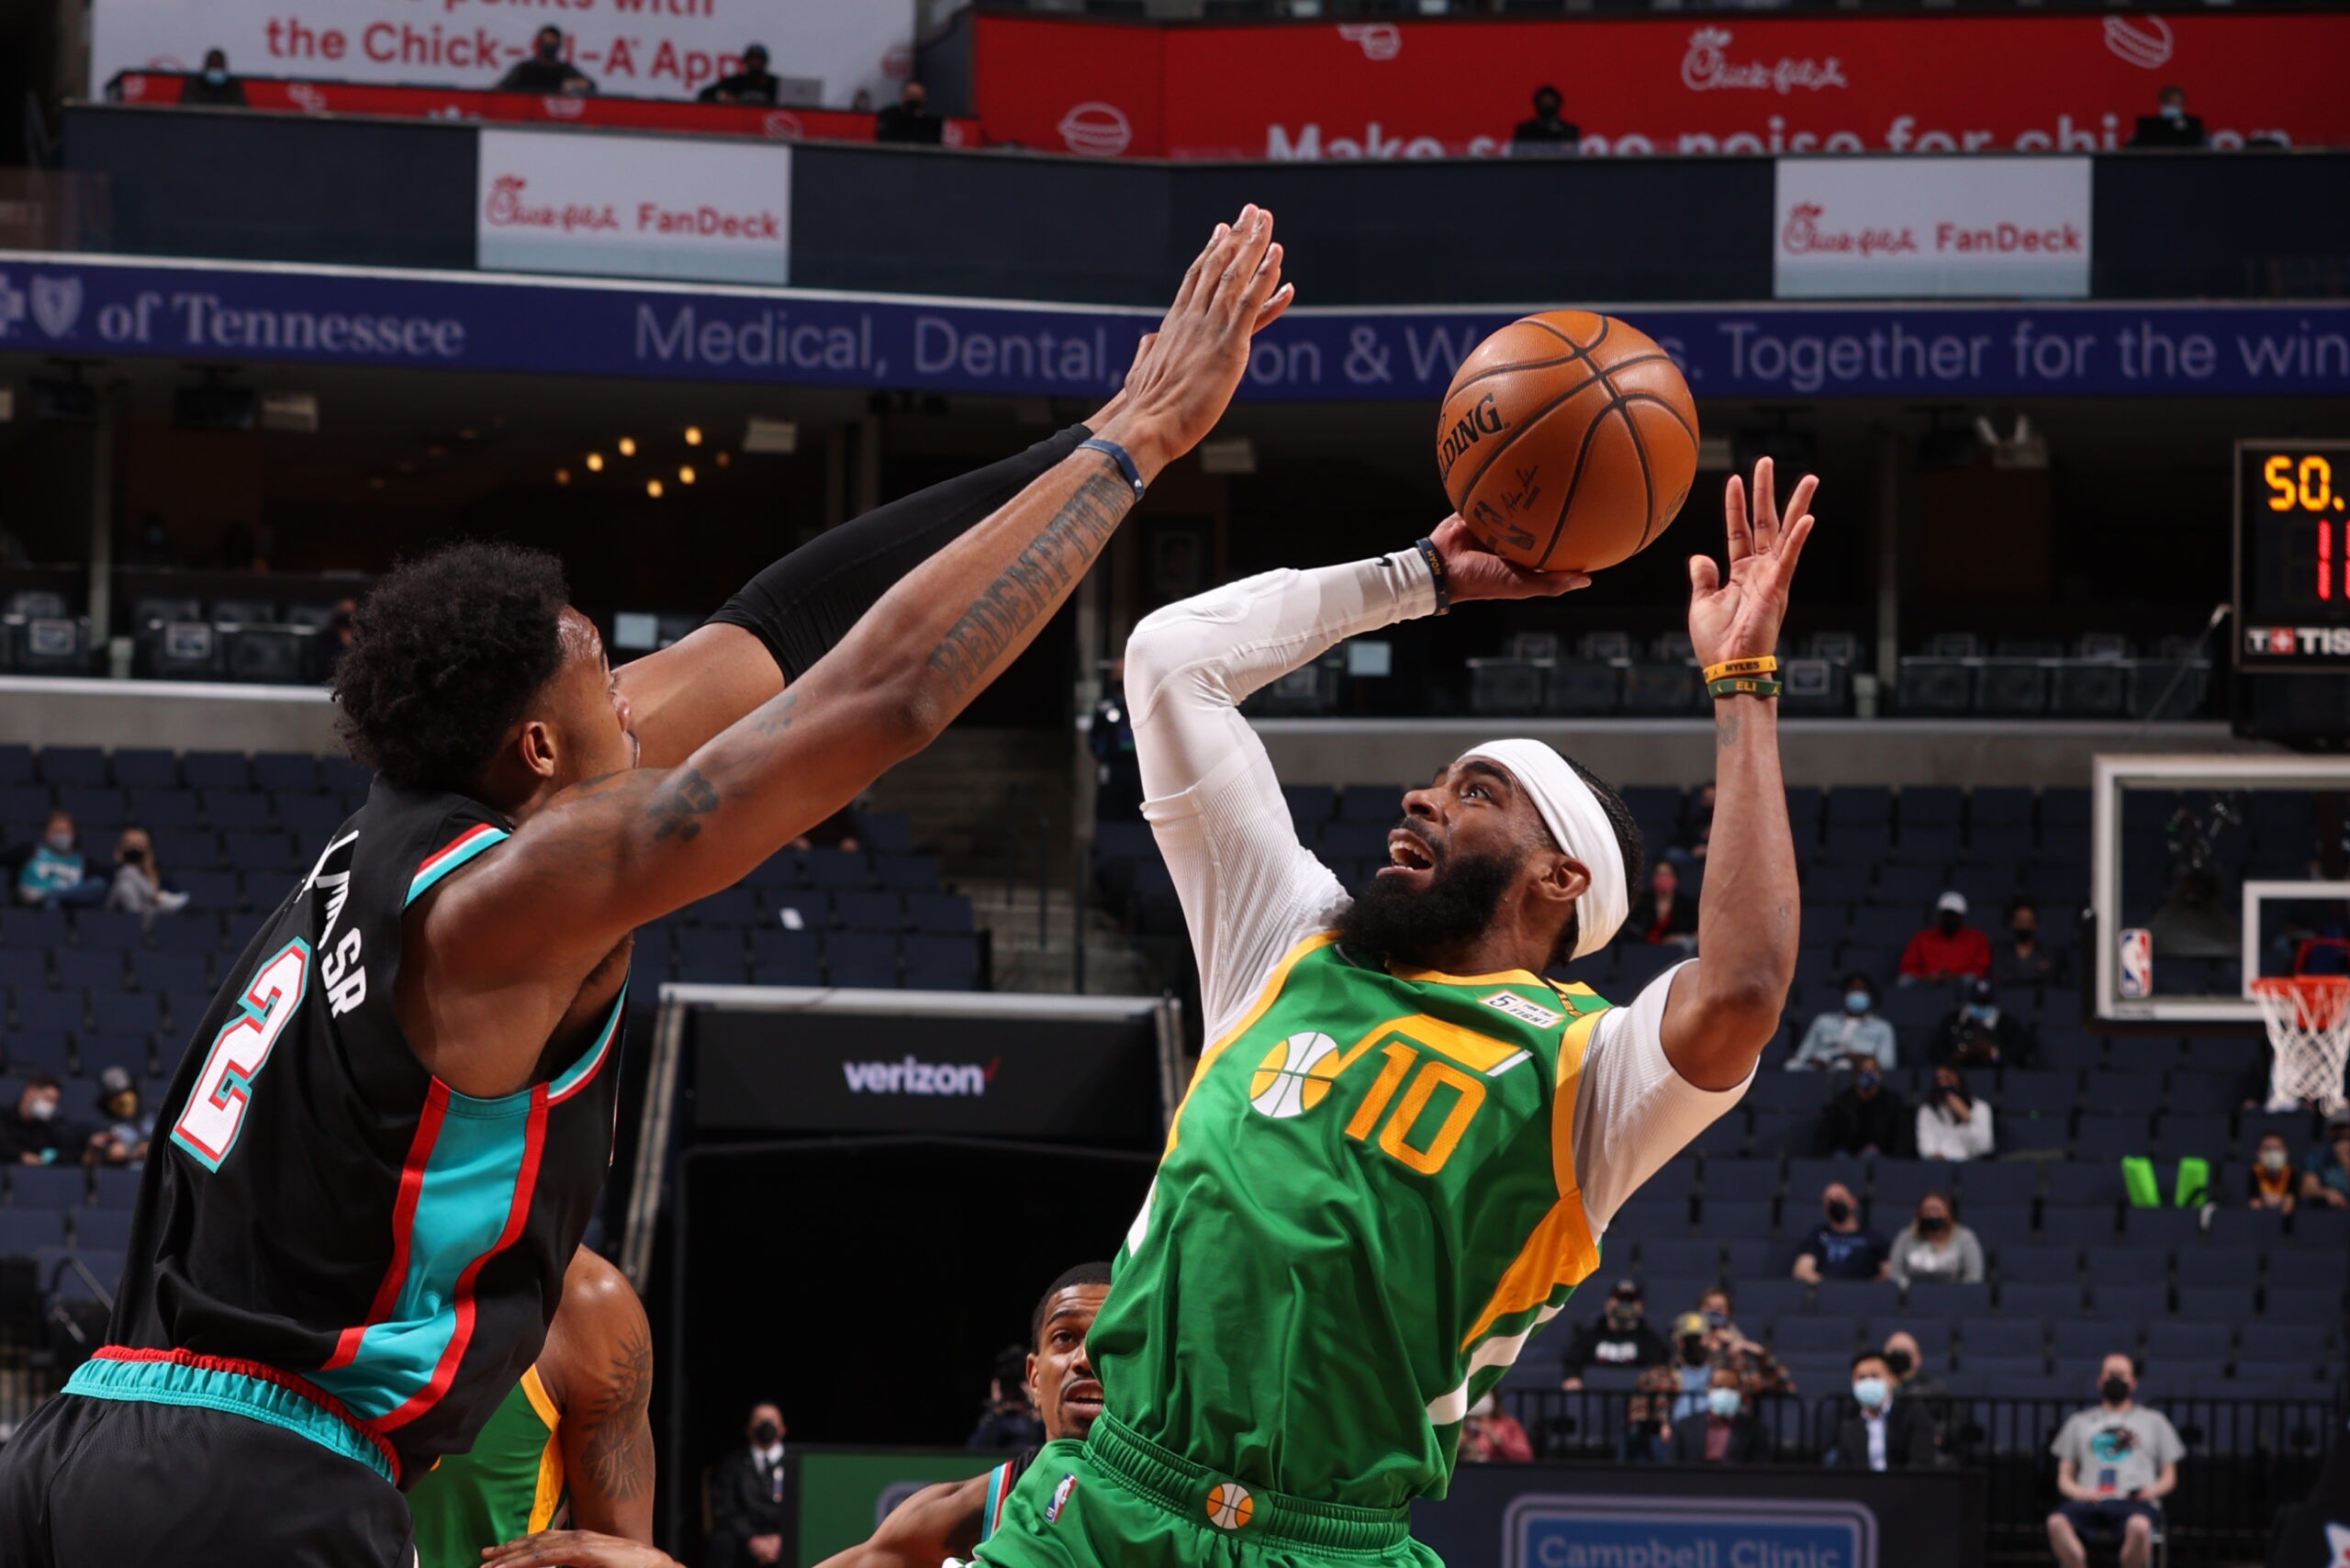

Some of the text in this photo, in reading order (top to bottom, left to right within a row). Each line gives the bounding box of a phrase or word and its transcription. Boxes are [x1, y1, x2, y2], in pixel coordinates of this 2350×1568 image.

[266, 19, 346, 60] the
[636, 202, 779, 239] FanDeck
[1935, 223, 2081, 253] FanDeck
[97, 292, 465, 356] of Tennessee
[635, 304, 889, 379] Medical,
[1718, 321, 1991, 393] Together
[2011, 319, 2097, 379] for
[2116, 319, 2218, 379] the
[1724, 661, 1760, 672] MYLES
[1735, 680, 1758, 691] ELI
[1489, 994, 1519, 1008] 5
[1509, 1008, 1550, 1025] FIGHT
[170, 935, 311, 1174] 2
[842, 1054, 986, 1095] verizon
[1344, 1039, 1487, 1175] 10
